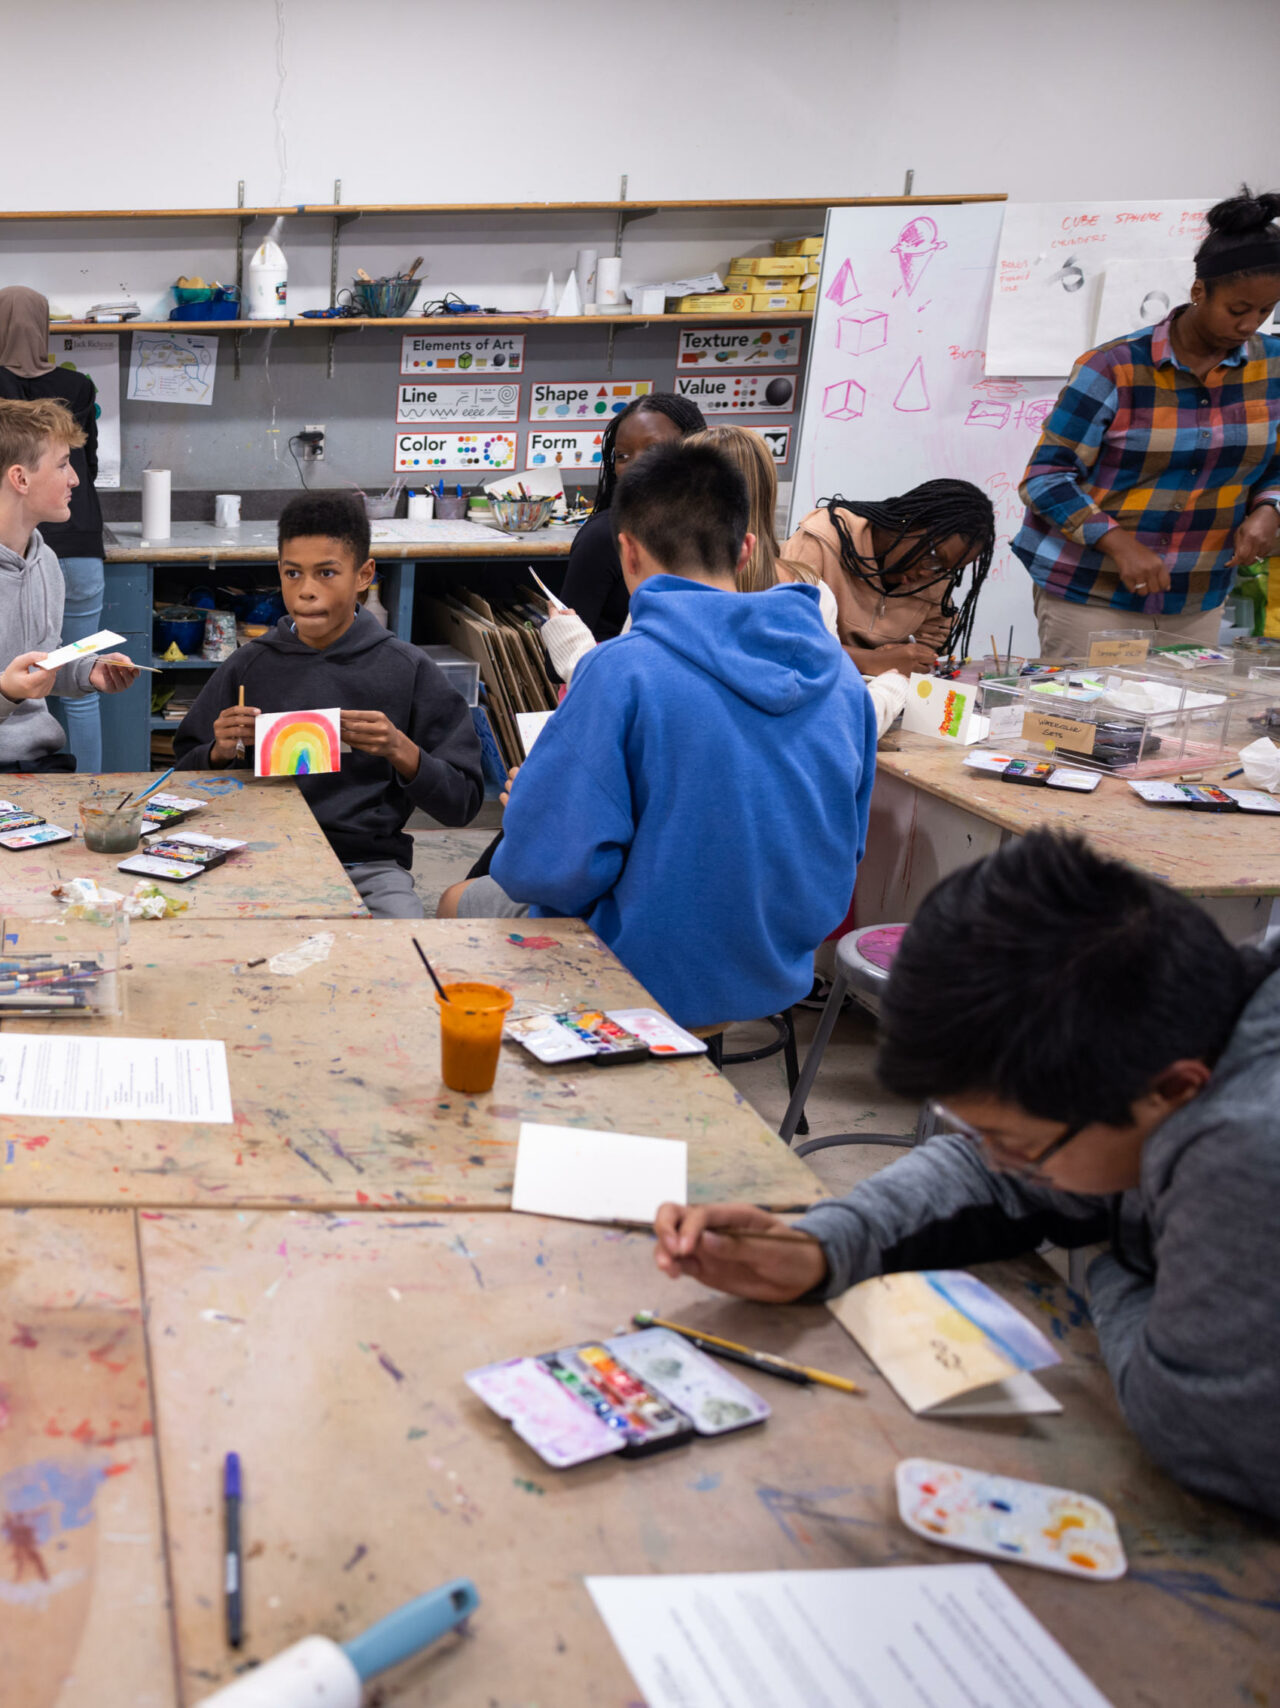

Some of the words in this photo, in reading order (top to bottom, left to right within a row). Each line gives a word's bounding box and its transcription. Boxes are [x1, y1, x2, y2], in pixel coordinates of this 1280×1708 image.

[1061, 214, 1100, 231] CUBE
[413, 340, 472, 351] Elements
[475, 338, 490, 350] of
[492, 339, 514, 350] Art
[683, 332, 749, 348] Texture
[402, 388, 437, 402] Line
[535, 385, 588, 405] Shape
[678, 379, 726, 395] Value
[400, 435, 447, 452] Color
[532, 434, 577, 449] Form
